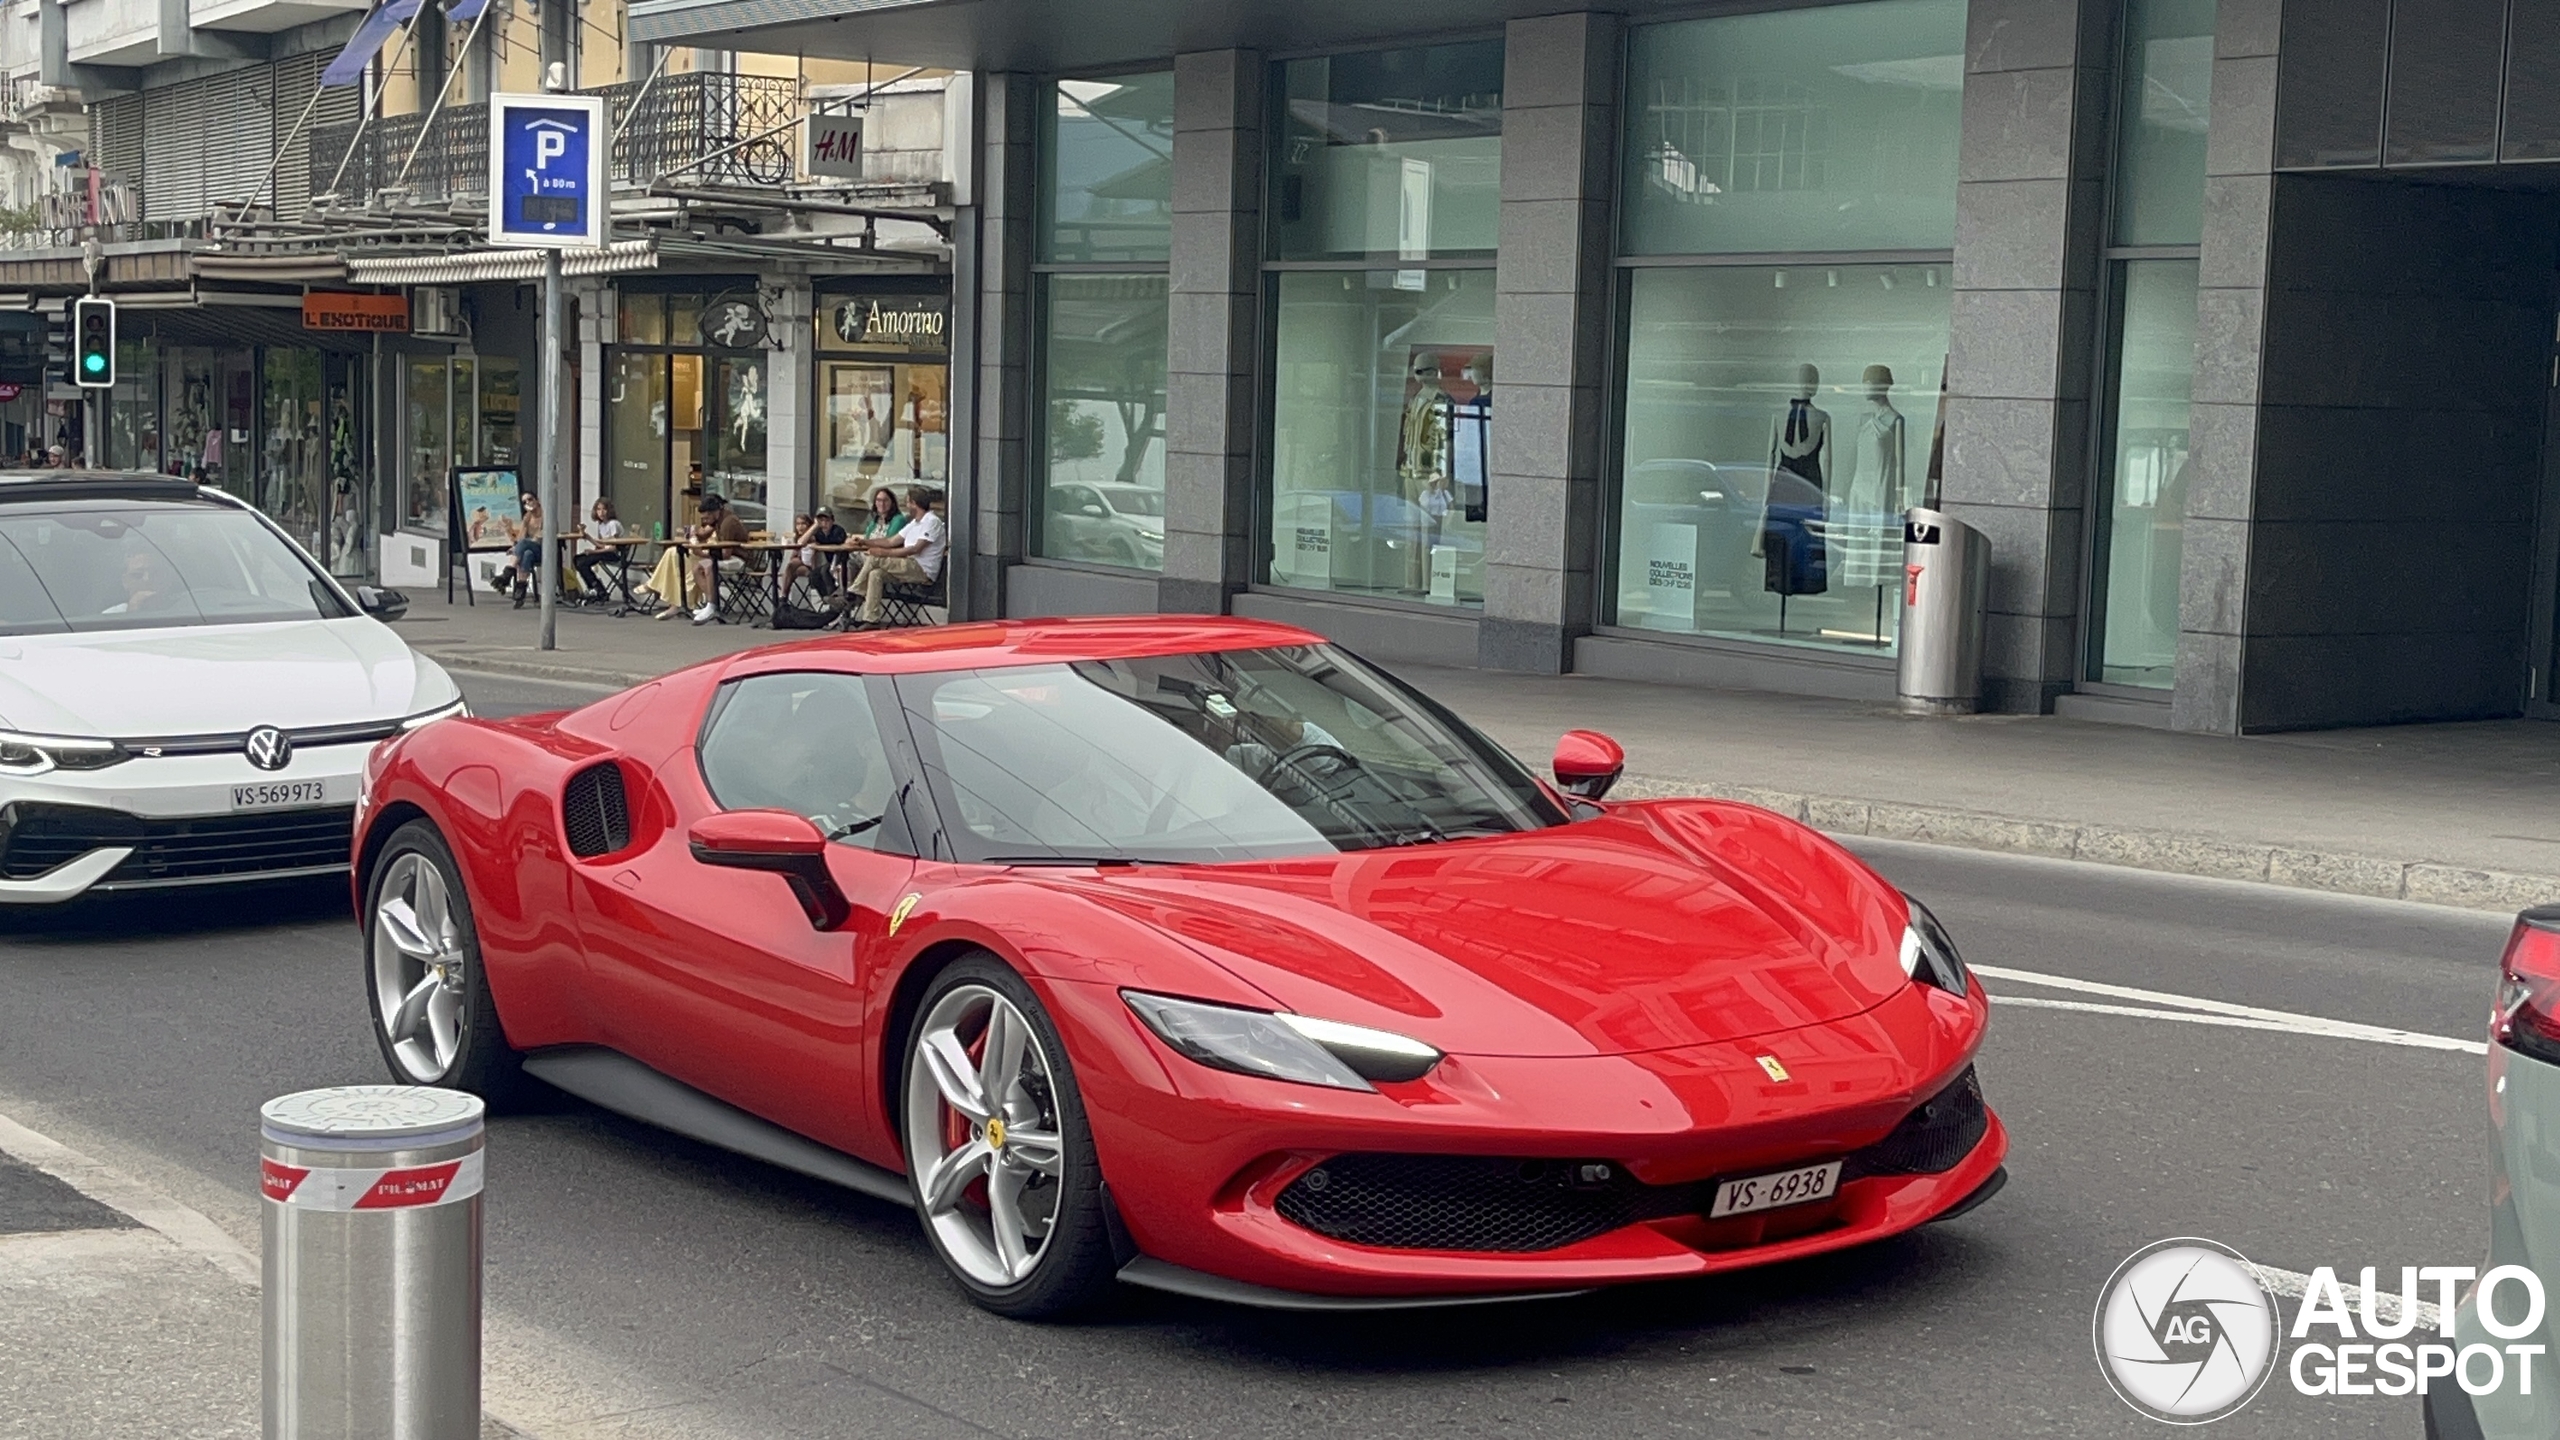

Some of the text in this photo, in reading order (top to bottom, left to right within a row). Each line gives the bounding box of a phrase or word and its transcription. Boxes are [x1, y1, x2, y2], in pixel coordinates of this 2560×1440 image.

[537, 130, 565, 170] P
[813, 129, 858, 164] H&M
[865, 300, 943, 335] Amorino
